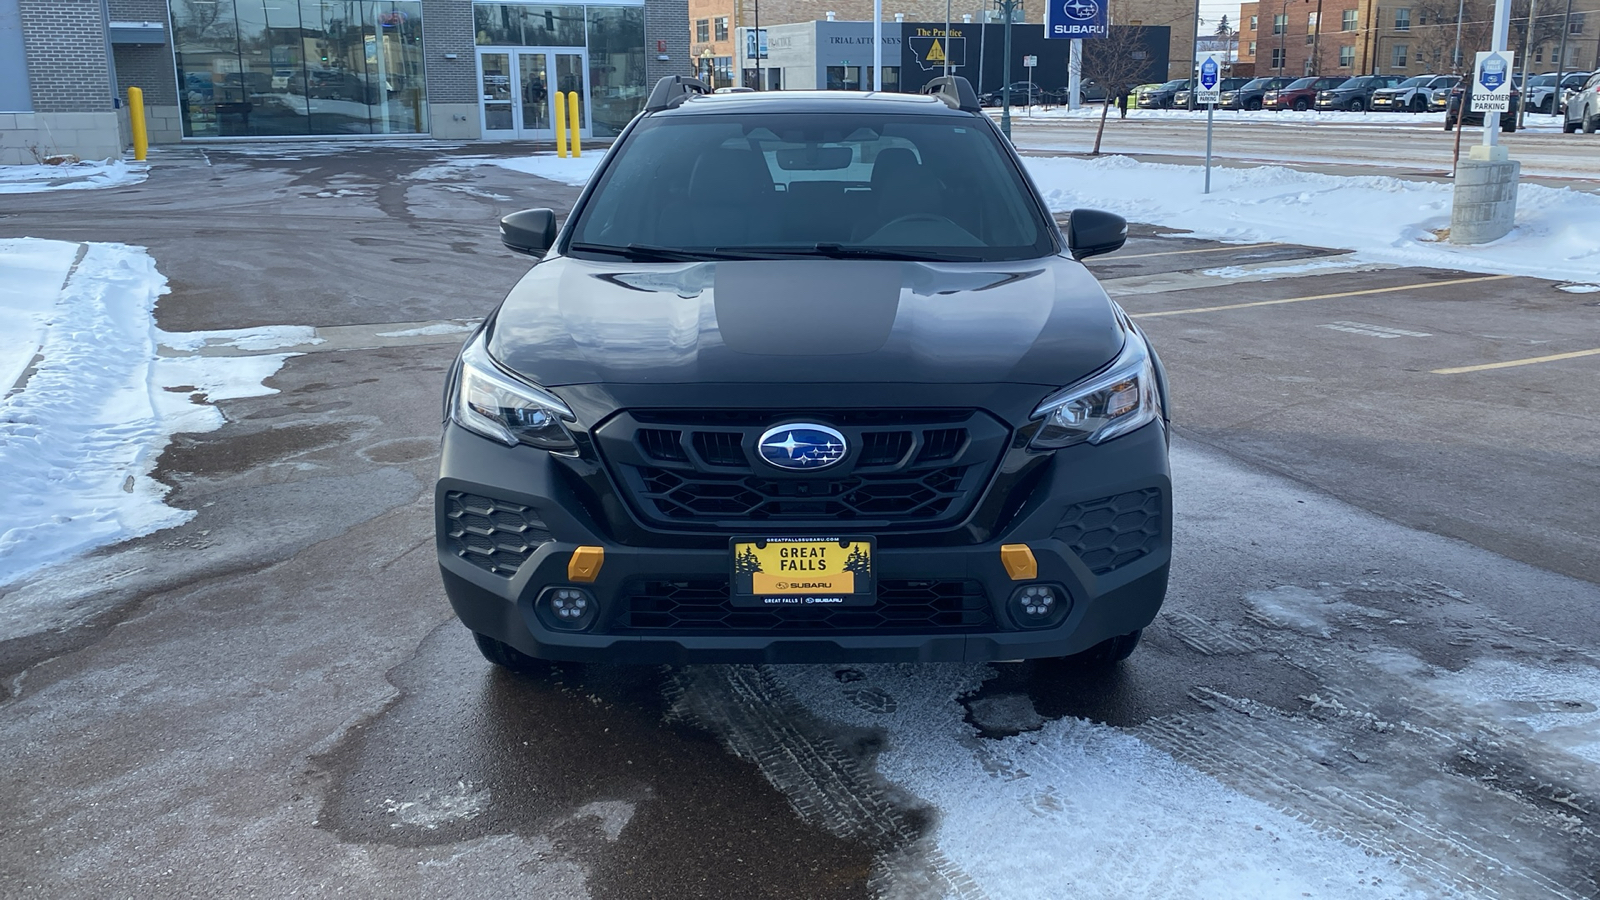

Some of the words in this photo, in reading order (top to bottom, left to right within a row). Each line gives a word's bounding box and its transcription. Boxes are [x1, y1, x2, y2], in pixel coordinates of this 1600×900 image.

[916, 28, 931, 36] The
[933, 28, 962, 36] Pratice
[1054, 25, 1104, 34] SUBARU
[768, 37, 792, 47] PRACTICE
[780, 547, 827, 558] GREAT
[780, 559, 827, 571] FALLS
